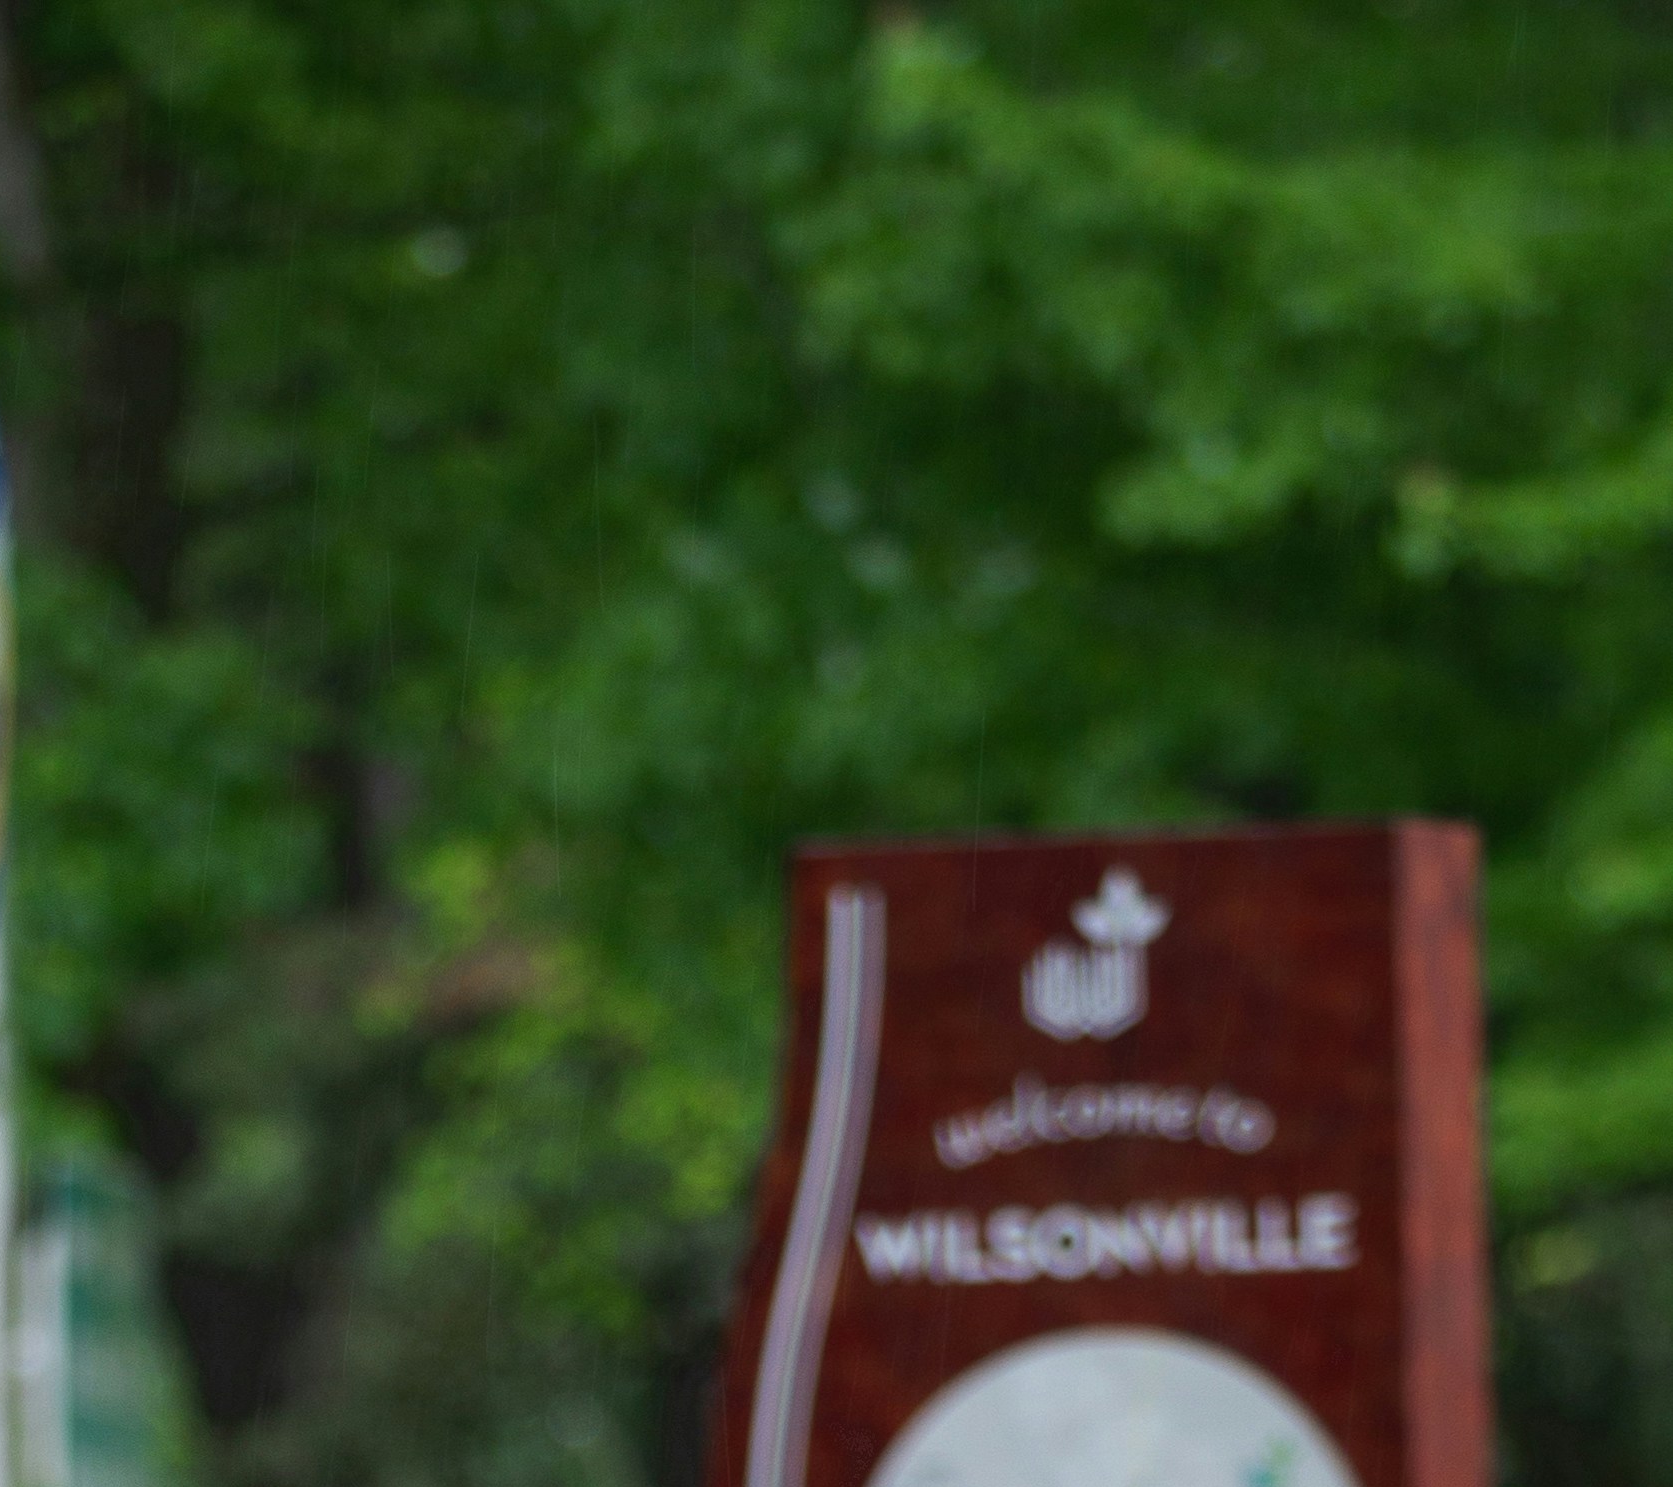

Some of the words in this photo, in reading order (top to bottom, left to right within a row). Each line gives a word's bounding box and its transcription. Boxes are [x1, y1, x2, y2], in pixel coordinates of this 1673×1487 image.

[935, 1074, 1195, 1168] welcome
[1199, 1087, 1275, 1154] to
[856, 1193, 1357, 1282] WILSONVILLE
